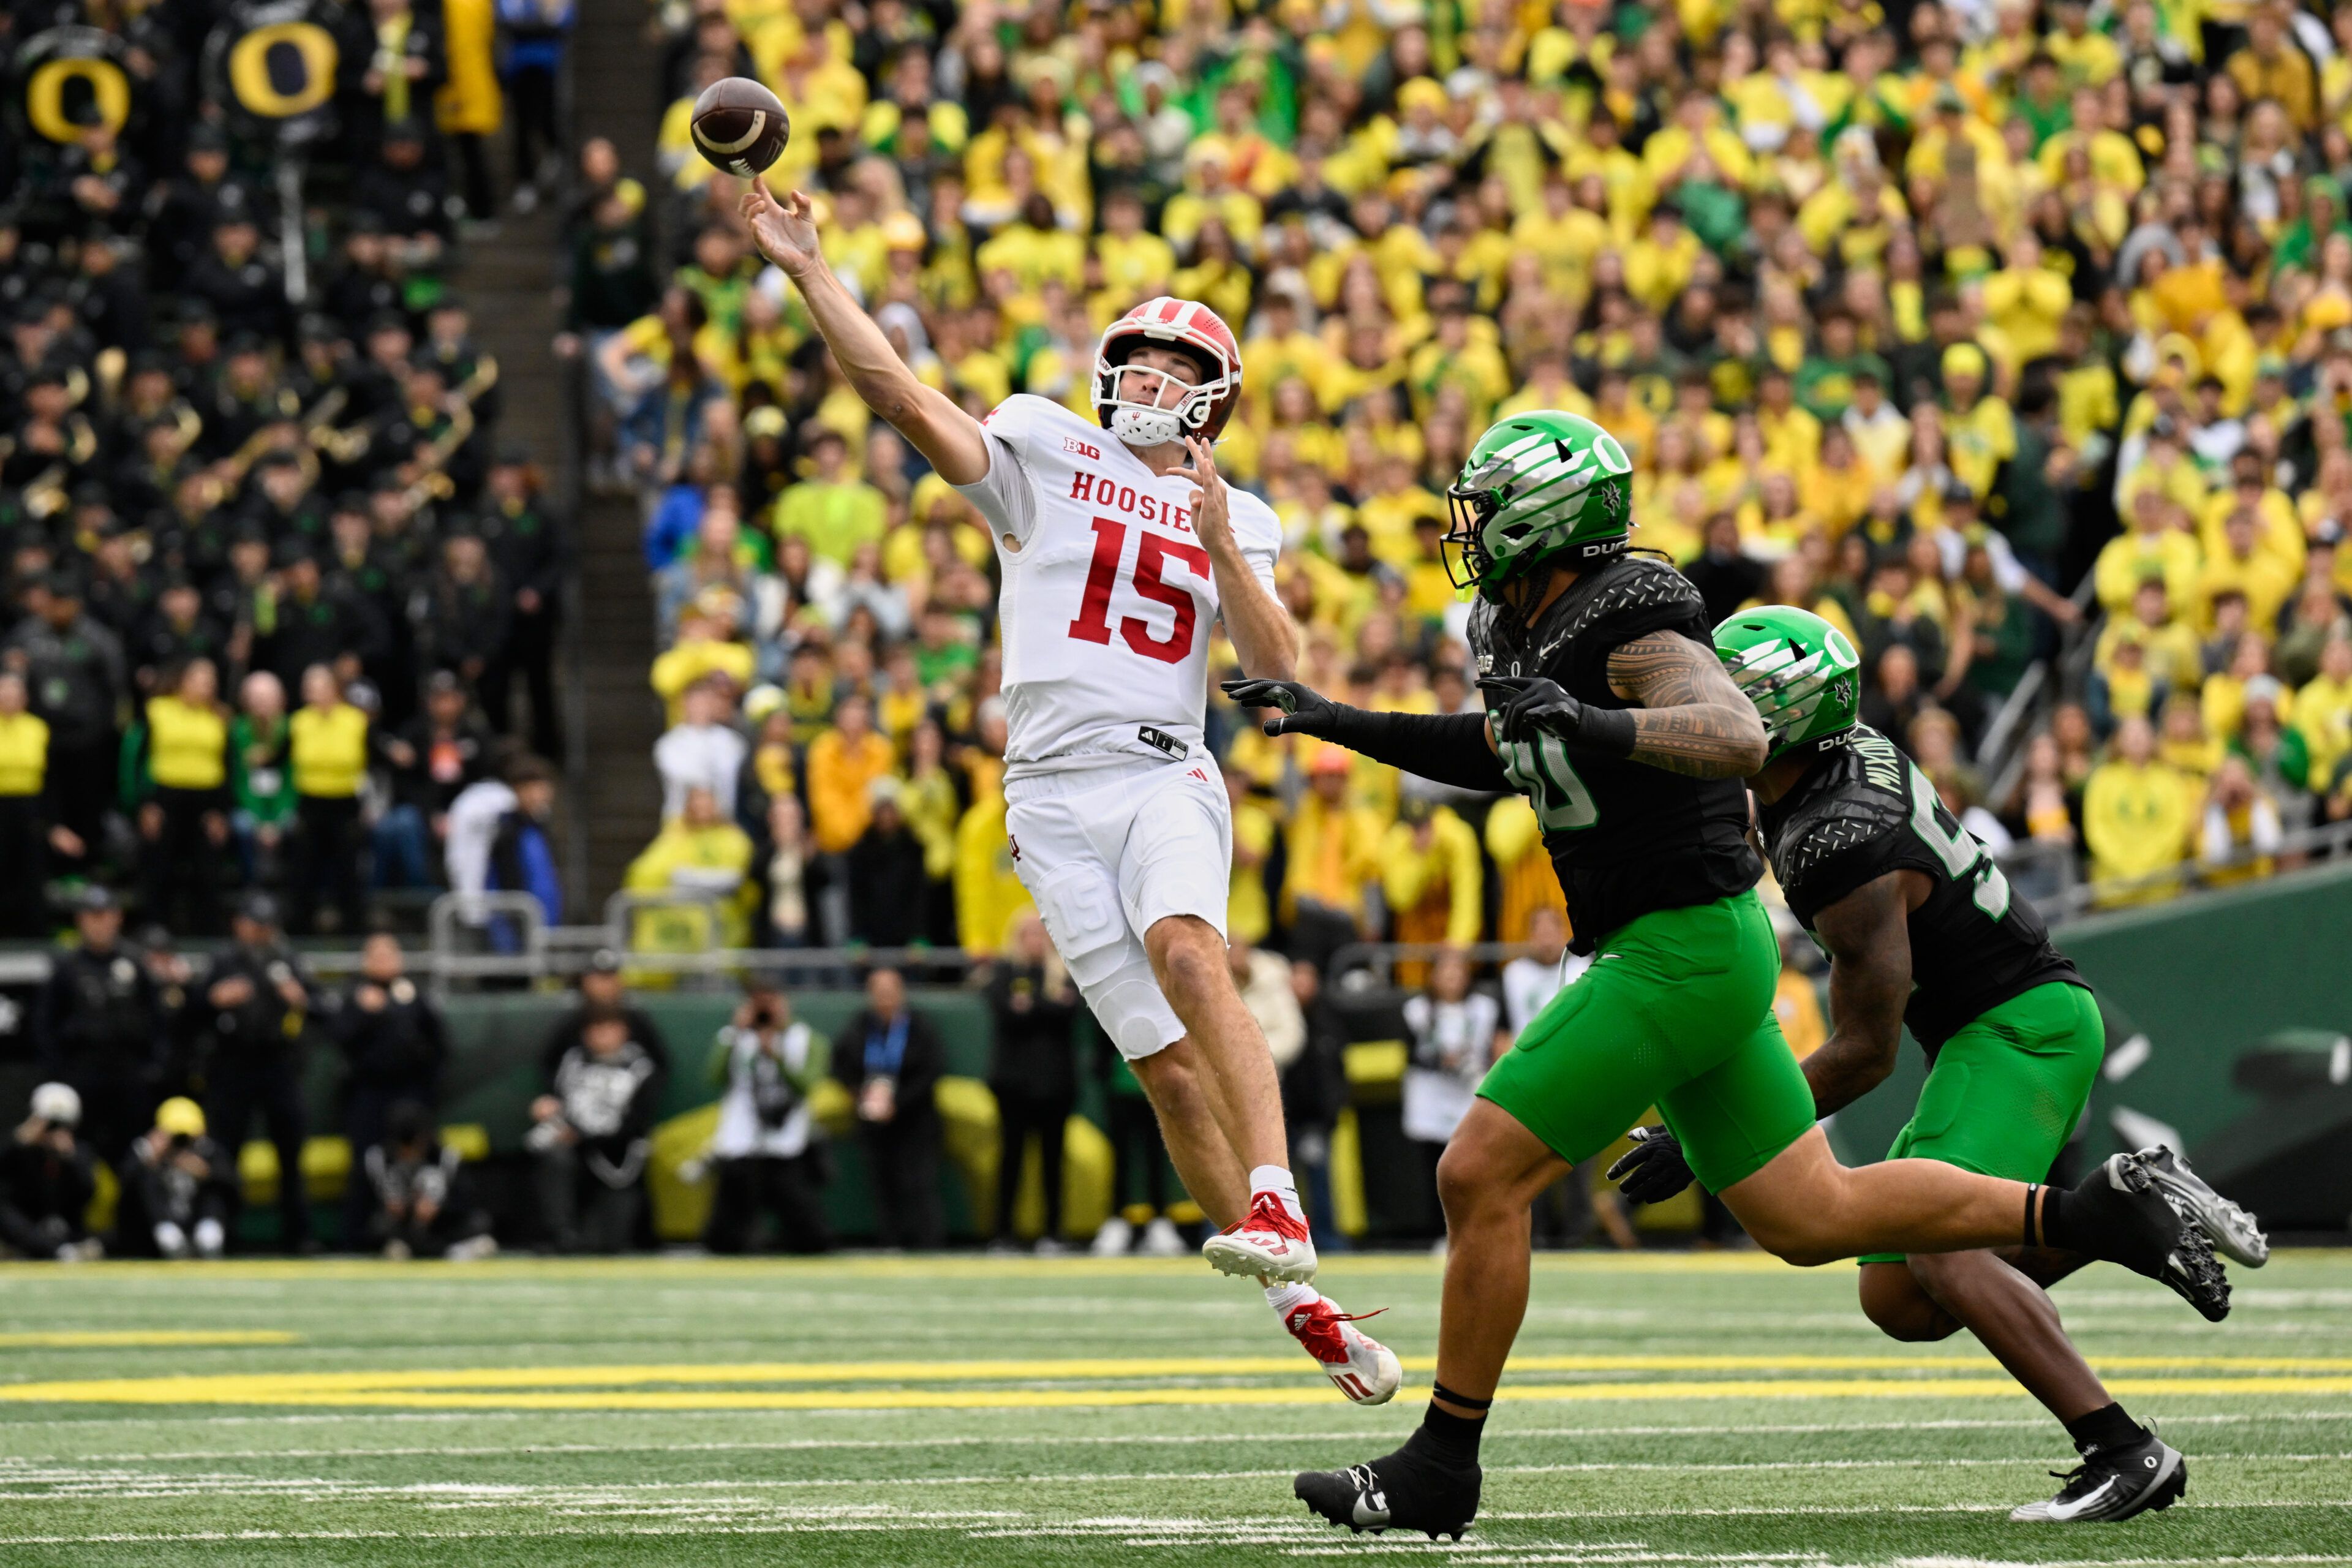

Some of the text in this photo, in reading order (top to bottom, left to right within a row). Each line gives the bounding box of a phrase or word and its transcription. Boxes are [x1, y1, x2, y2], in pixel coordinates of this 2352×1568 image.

[229, 21, 338, 118] O
[1069, 471, 1191, 533] HOOSIE
[1068, 516, 1210, 665] 15
[1852, 737, 1902, 795] MIXON
[1295, 1313, 1312, 1331] adidas
